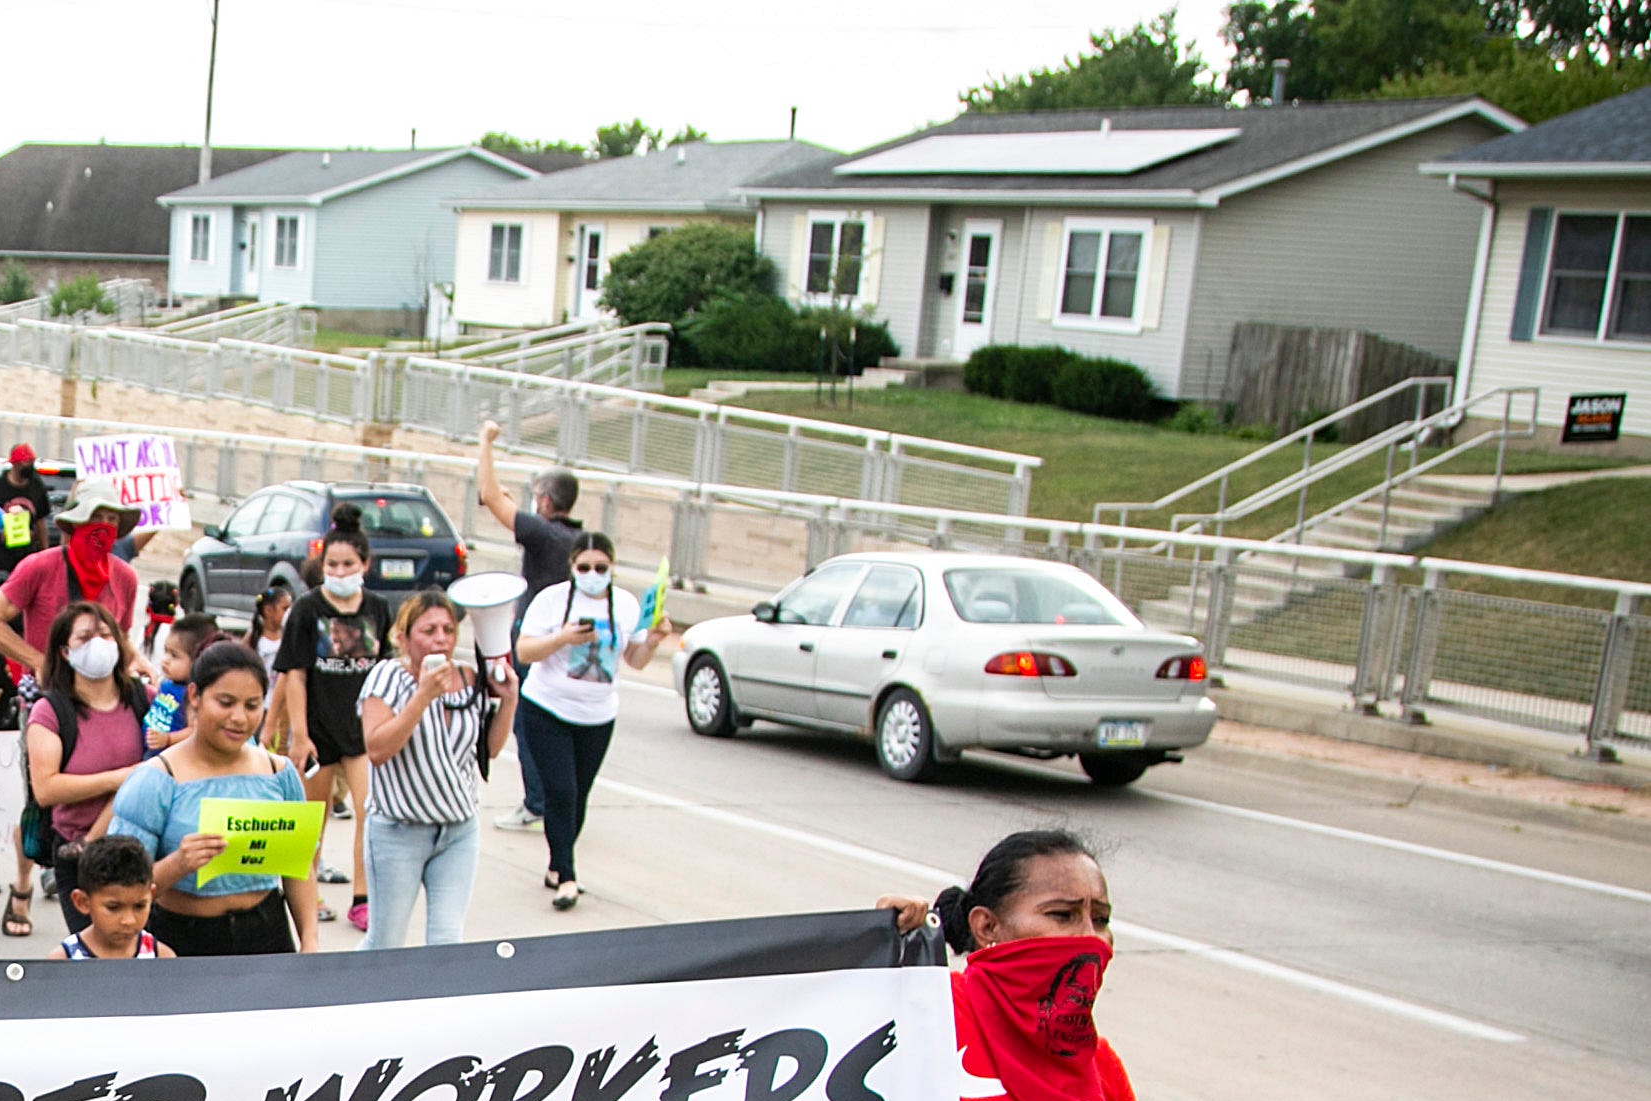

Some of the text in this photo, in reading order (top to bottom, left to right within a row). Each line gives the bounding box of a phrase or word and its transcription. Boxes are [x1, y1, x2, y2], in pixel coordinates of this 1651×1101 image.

[78, 440, 129, 475] WHAT
[136, 502, 171, 527] OR?
[227, 816, 296, 831] Eschucha
[249, 839, 267, 850] Mi
